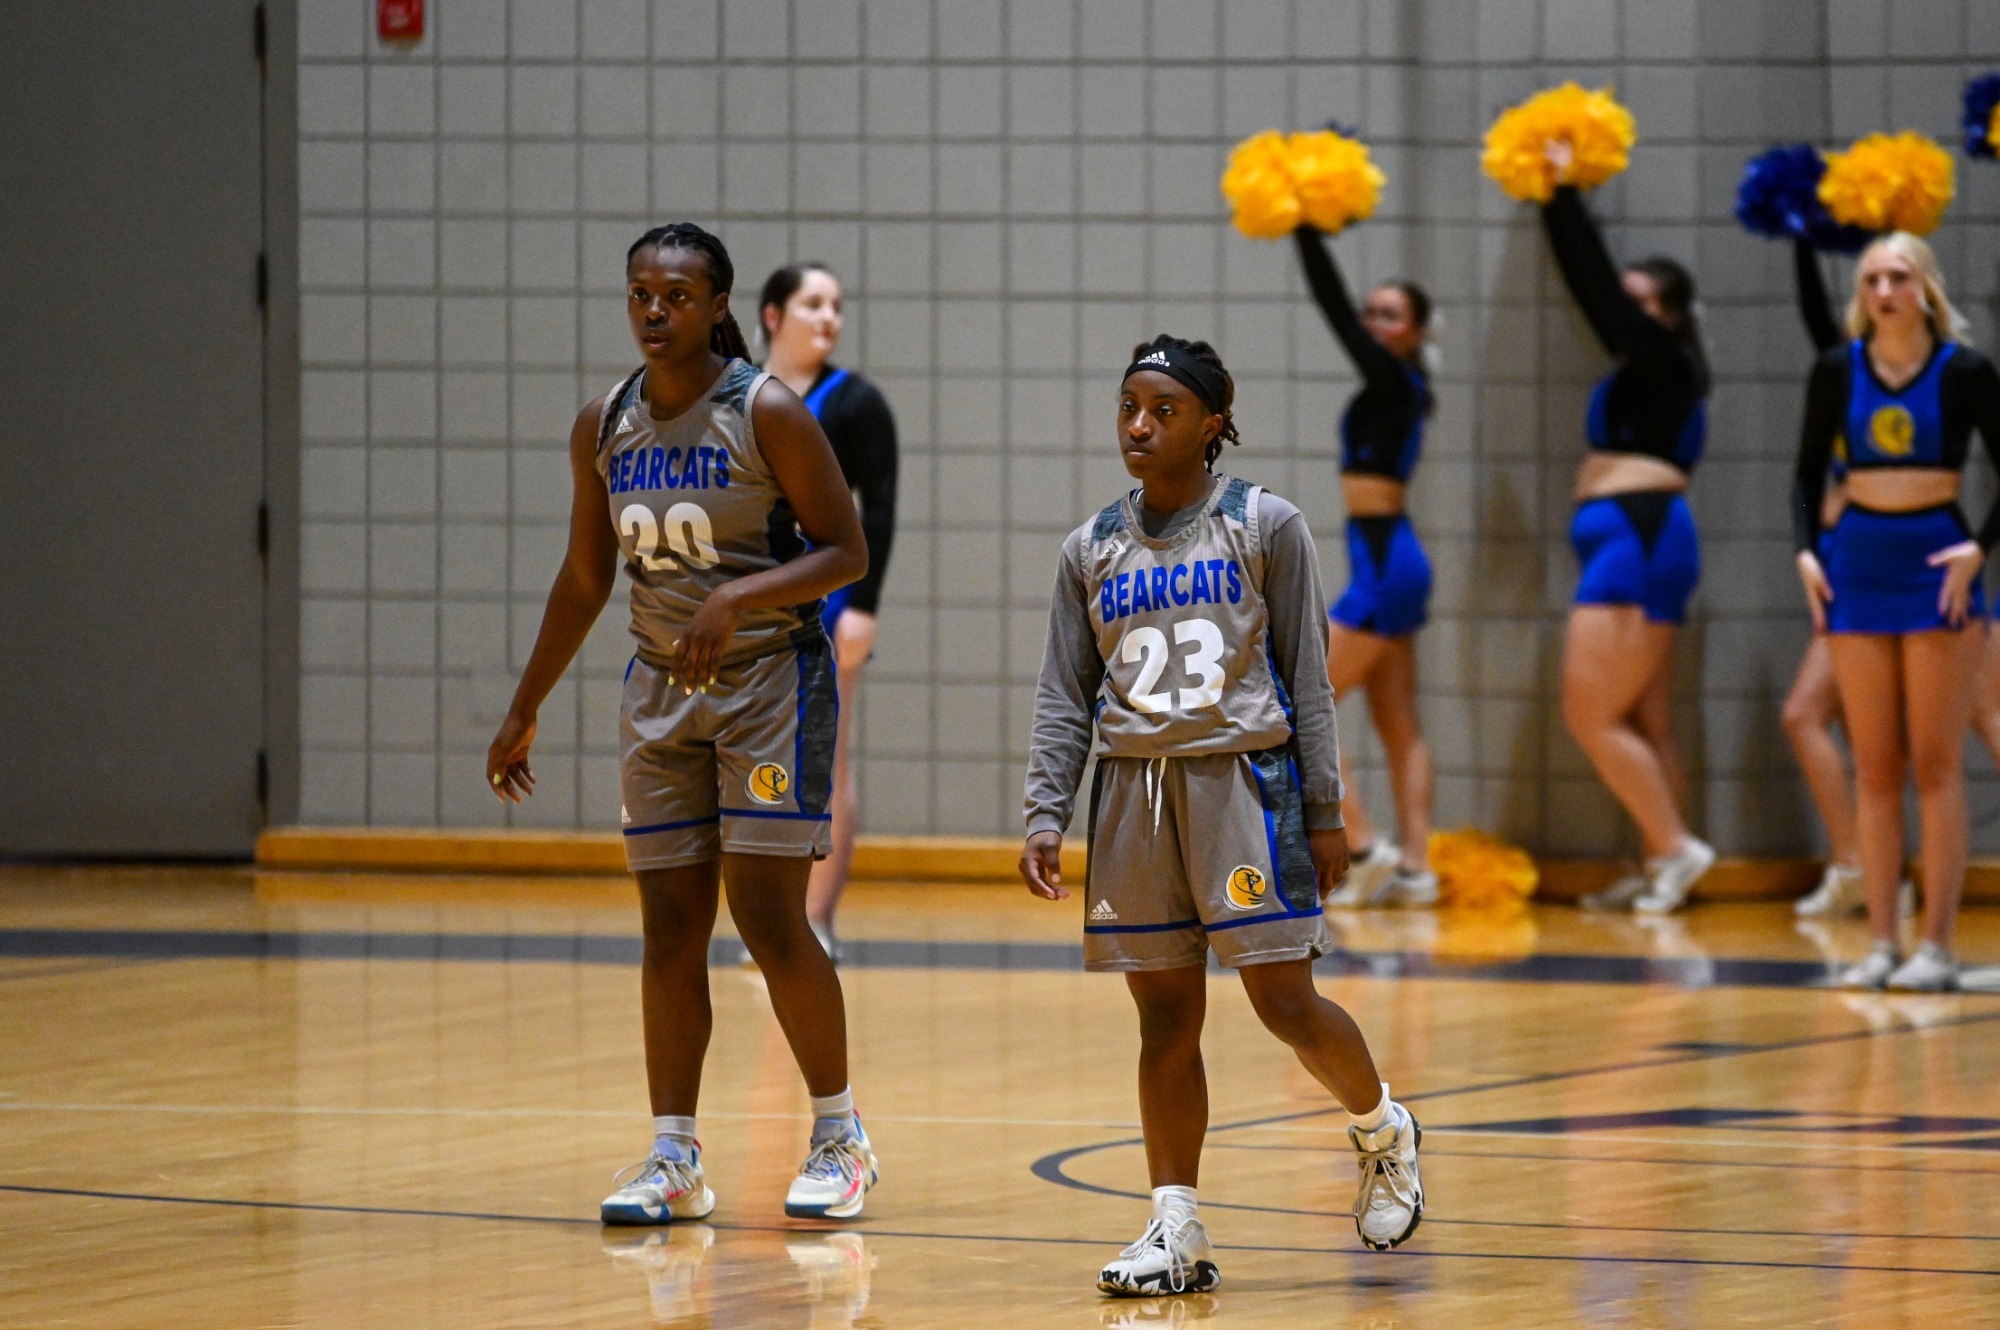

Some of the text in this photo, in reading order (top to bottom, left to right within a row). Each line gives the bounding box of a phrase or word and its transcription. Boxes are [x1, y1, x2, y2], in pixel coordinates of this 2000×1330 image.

[608, 446, 730, 494] BEARCATS
[620, 502, 720, 571] 20
[1101, 559, 1241, 623] BEARCATS
[1122, 618, 1225, 713] 23
[1089, 911, 1118, 920] adidas
